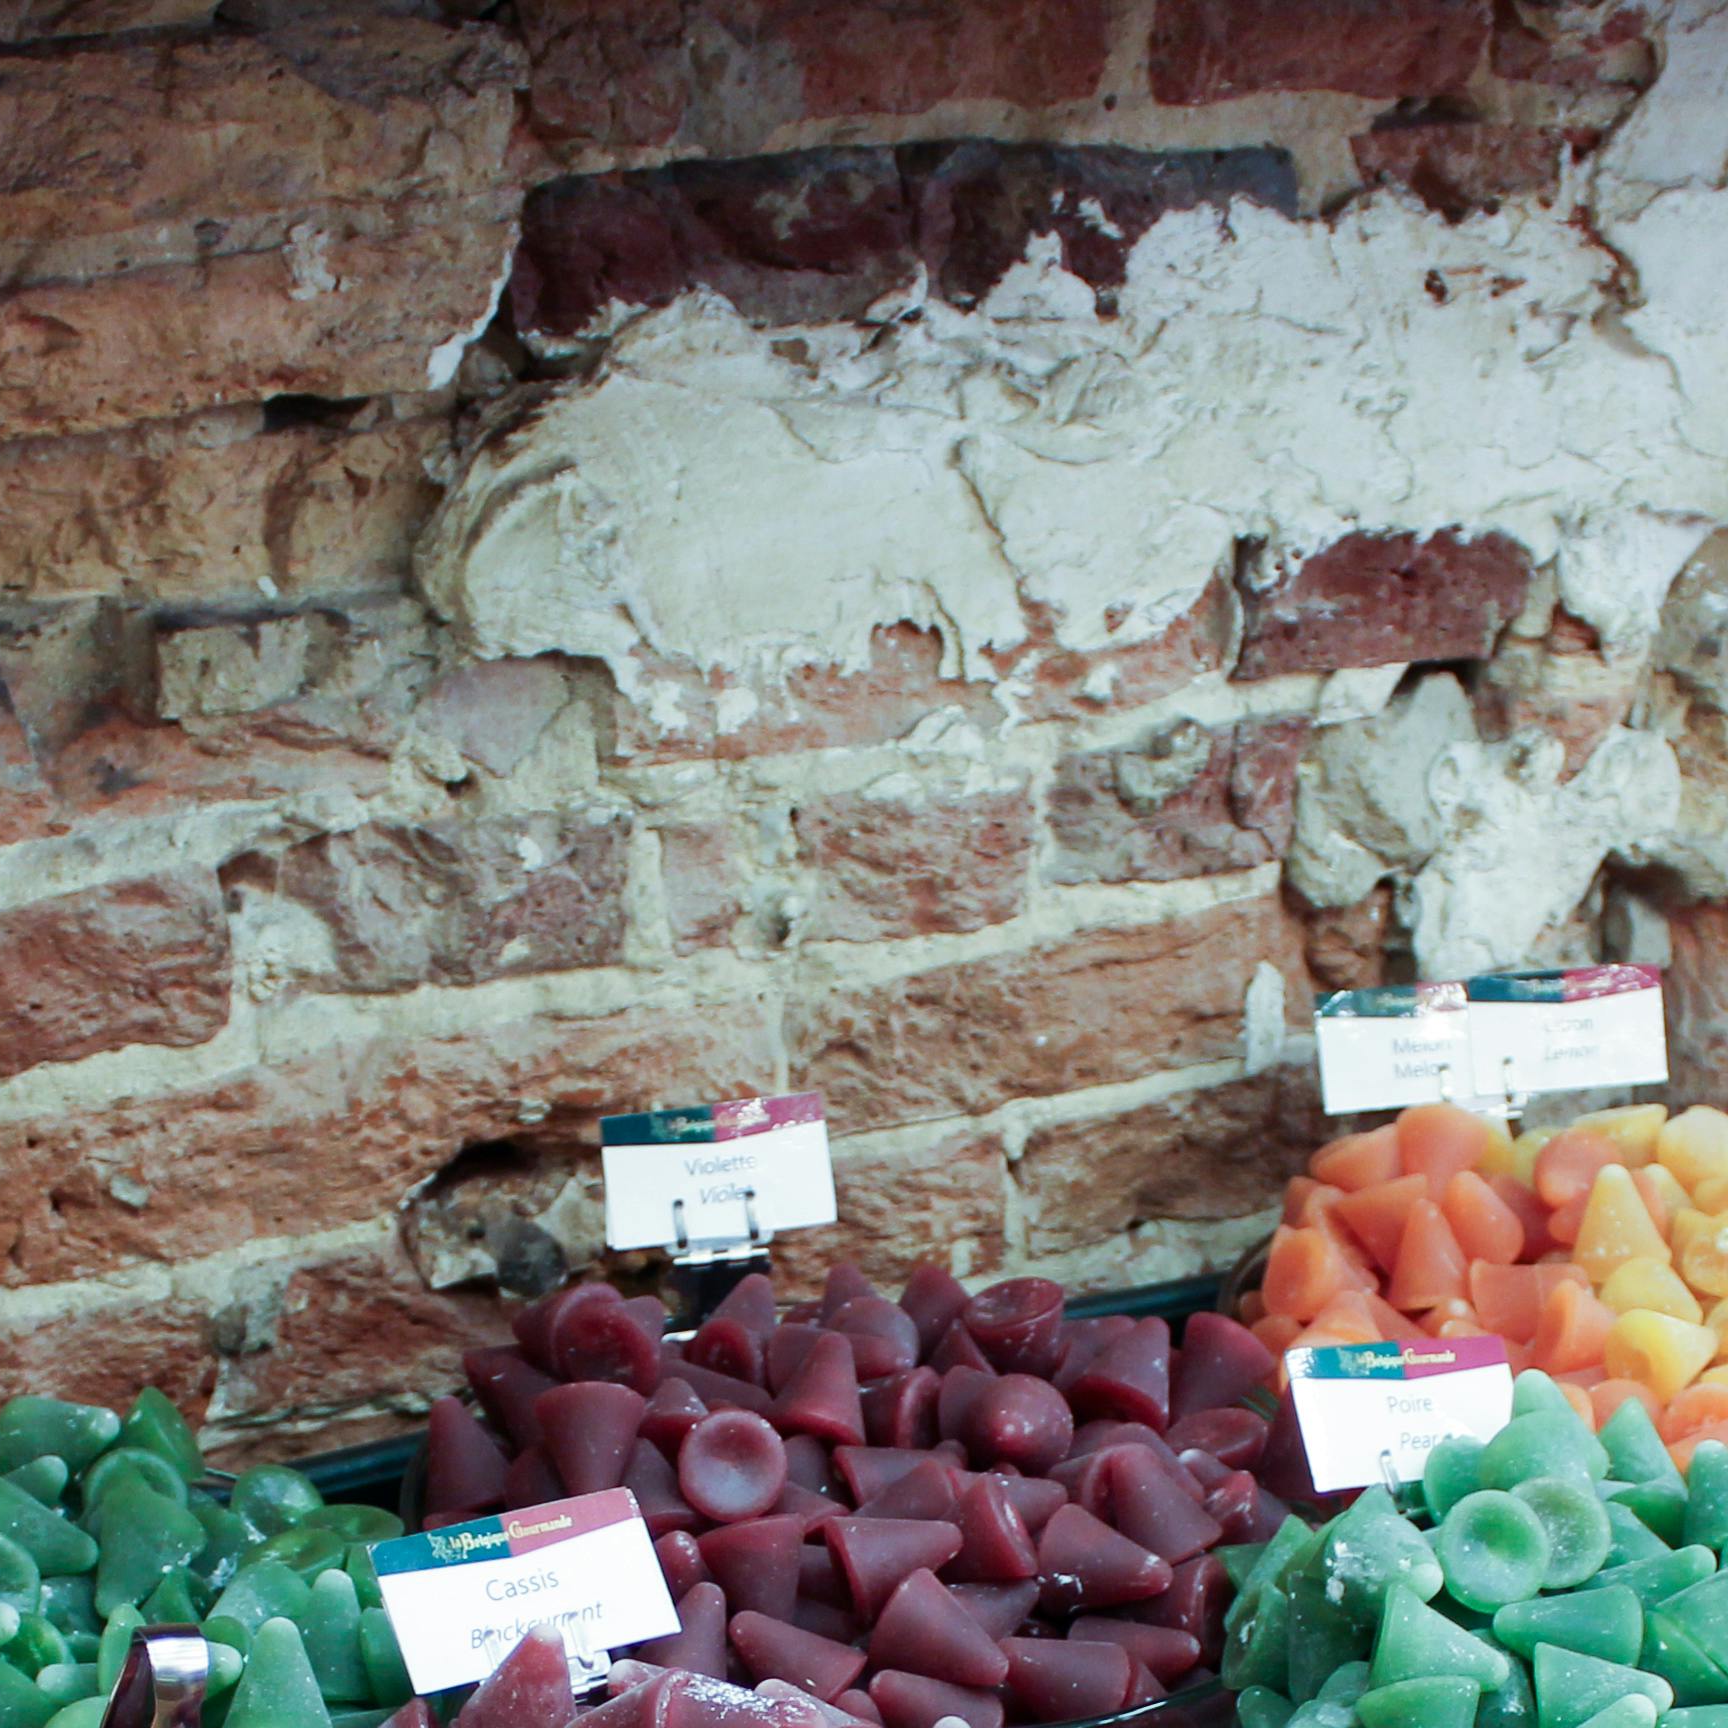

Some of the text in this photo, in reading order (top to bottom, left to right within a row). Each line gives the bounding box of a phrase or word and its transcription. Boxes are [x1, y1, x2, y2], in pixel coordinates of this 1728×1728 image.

[683, 1155, 758, 1176] Violette
[699, 1182, 753, 1205] Viole
[1386, 1394, 1433, 1413] Poire
[1400, 1432, 1439, 1451] Pear
[485, 1567, 560, 1602] Cassis
